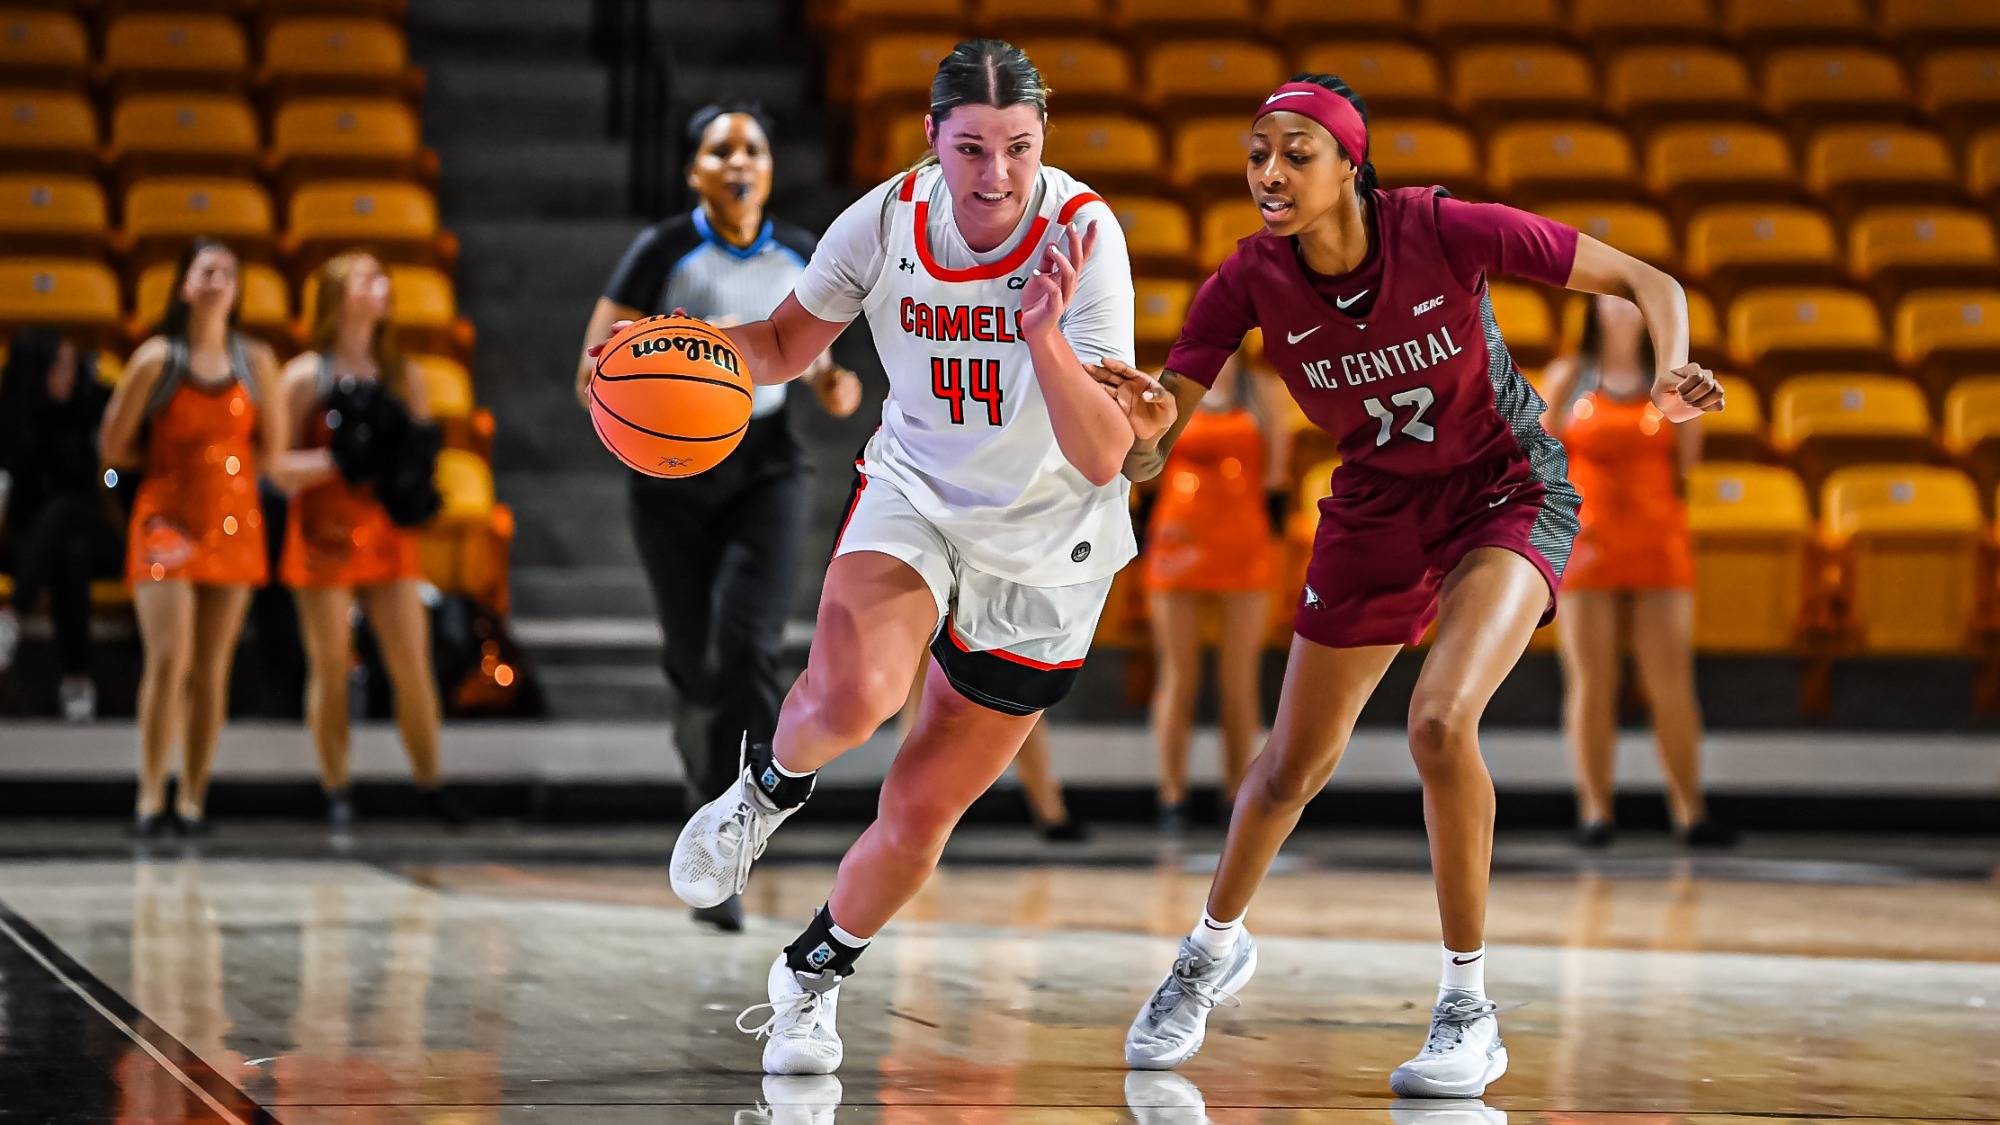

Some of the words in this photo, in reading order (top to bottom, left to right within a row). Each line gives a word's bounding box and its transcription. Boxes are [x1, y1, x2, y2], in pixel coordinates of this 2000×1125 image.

[1413, 295, 1444, 317] MEAC
[631, 336, 740, 377] Wilson
[1302, 359, 1338, 389] NC
[1341, 326, 1462, 386] CENTRAL
[930, 357, 1003, 426] 44
[1363, 387, 1435, 446] 12
